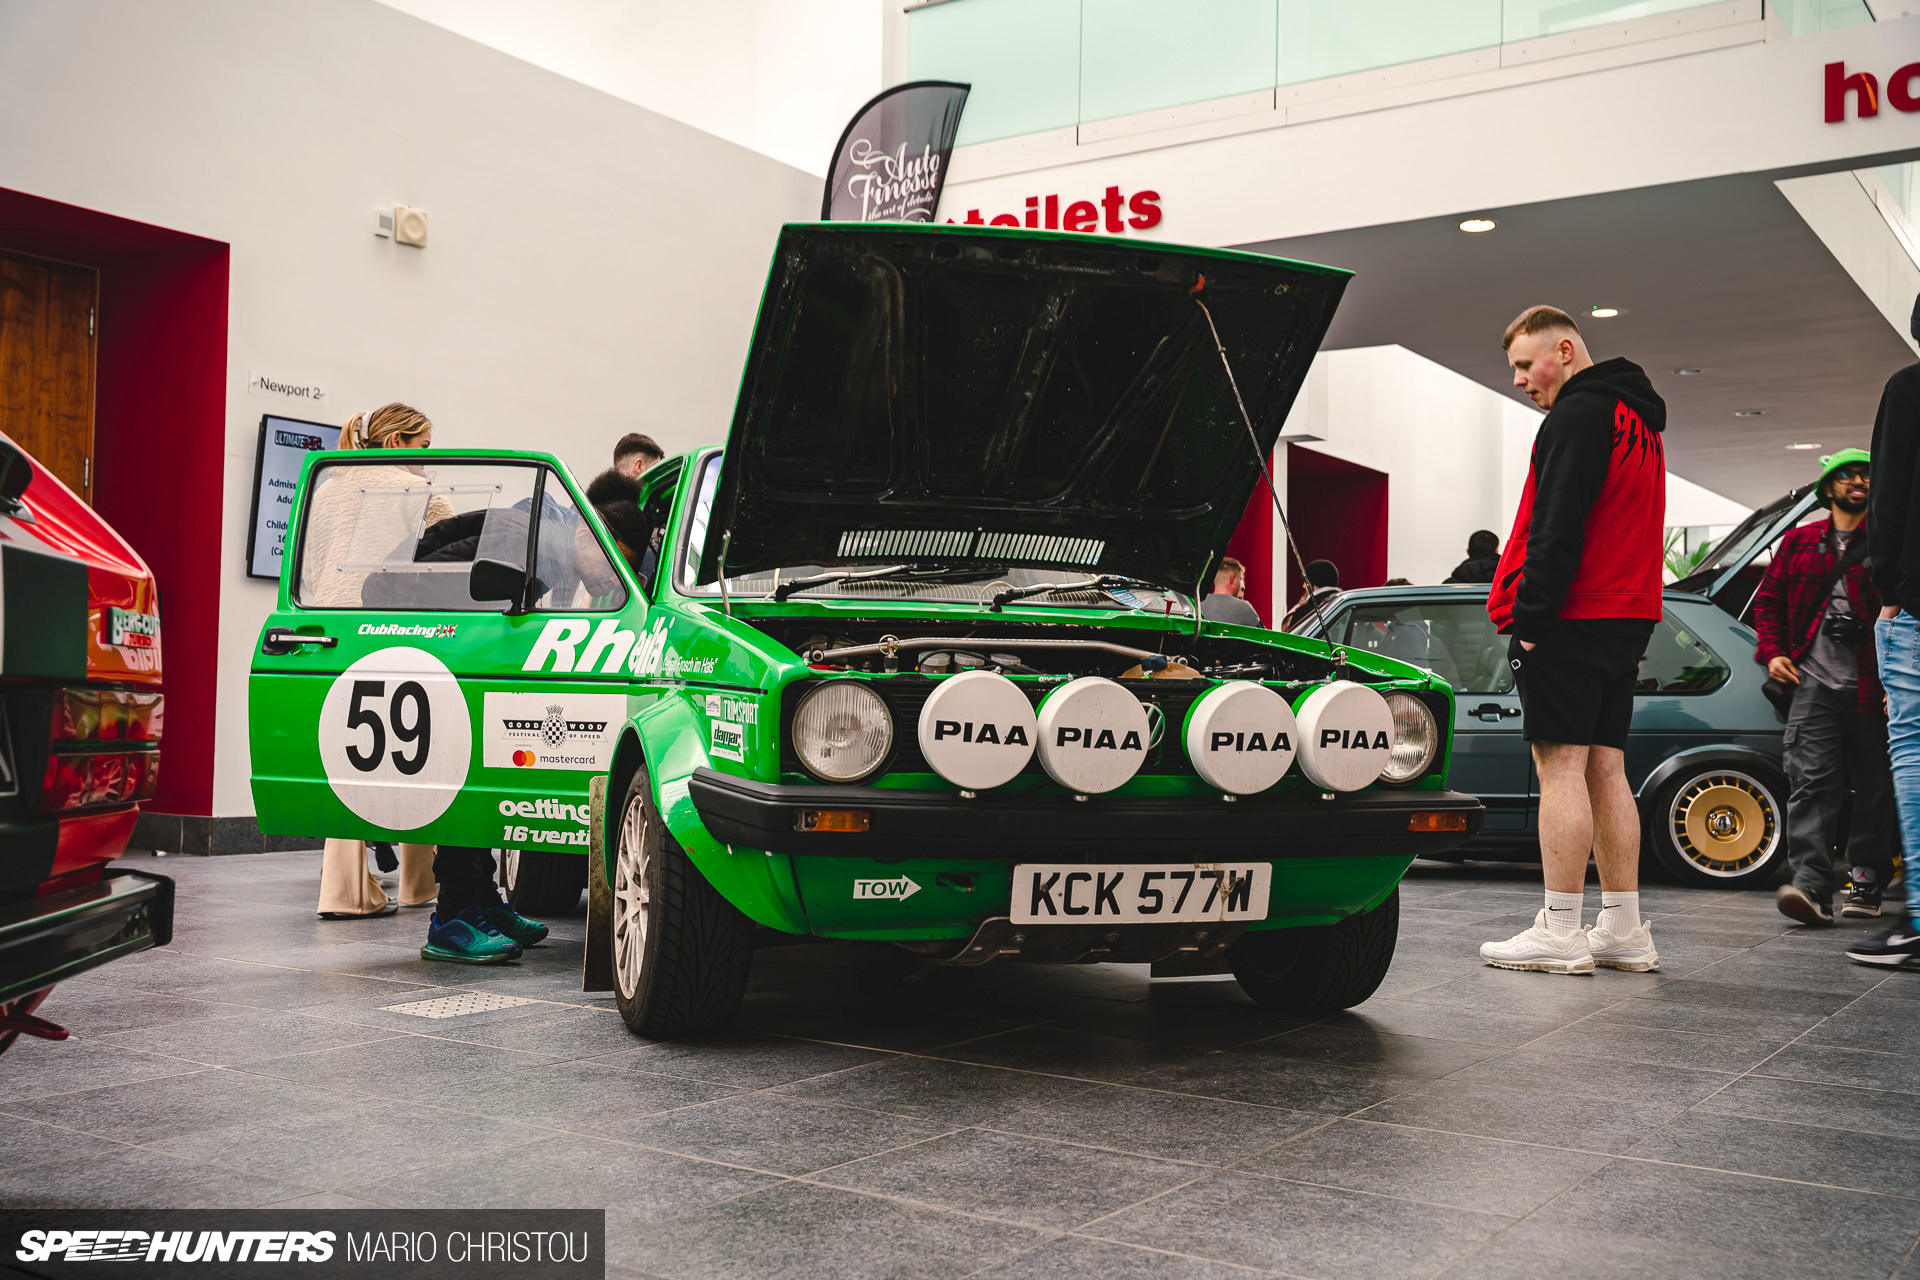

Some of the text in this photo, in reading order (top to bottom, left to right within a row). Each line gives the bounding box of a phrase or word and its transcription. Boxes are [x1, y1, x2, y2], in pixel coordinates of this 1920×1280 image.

[850, 138, 940, 187] Auto
[848, 170, 939, 222] Finesse
[260, 377, 321, 399] Newport 2
[276, 494, 294, 504] Adu
[345, 680, 431, 775] 59
[569, 723, 603, 731] WOOD
[934, 719, 1029, 747] PIAA
[1056, 726, 1142, 751] PIAA
[1210, 731, 1292, 752] PIAA
[1319, 729, 1390, 750] PIAA
[540, 755, 596, 765] mastercard
[857, 881, 909, 897] TOW
[1030, 869, 1254, 916] KCK 577W
